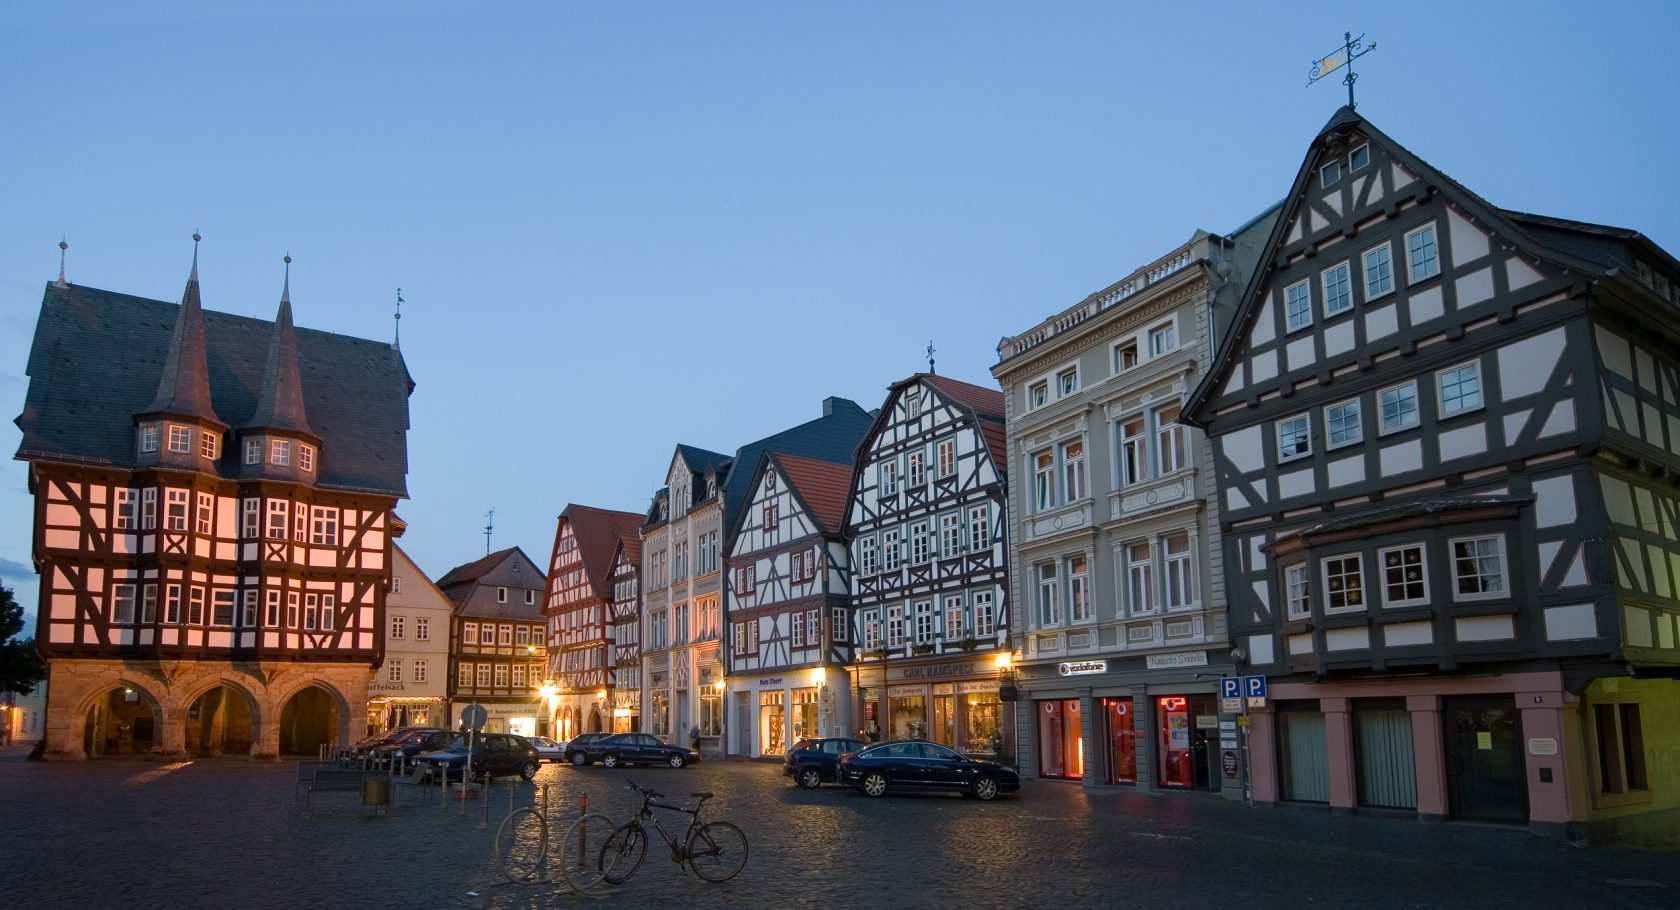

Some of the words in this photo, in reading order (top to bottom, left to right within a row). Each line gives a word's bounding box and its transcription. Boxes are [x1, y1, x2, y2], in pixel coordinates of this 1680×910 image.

[903, 667, 925, 678] CARL
[1070, 662, 1104, 672] vodafone
[1226, 680, 1236, 697] P
[1250, 678, 1261, 696] P
